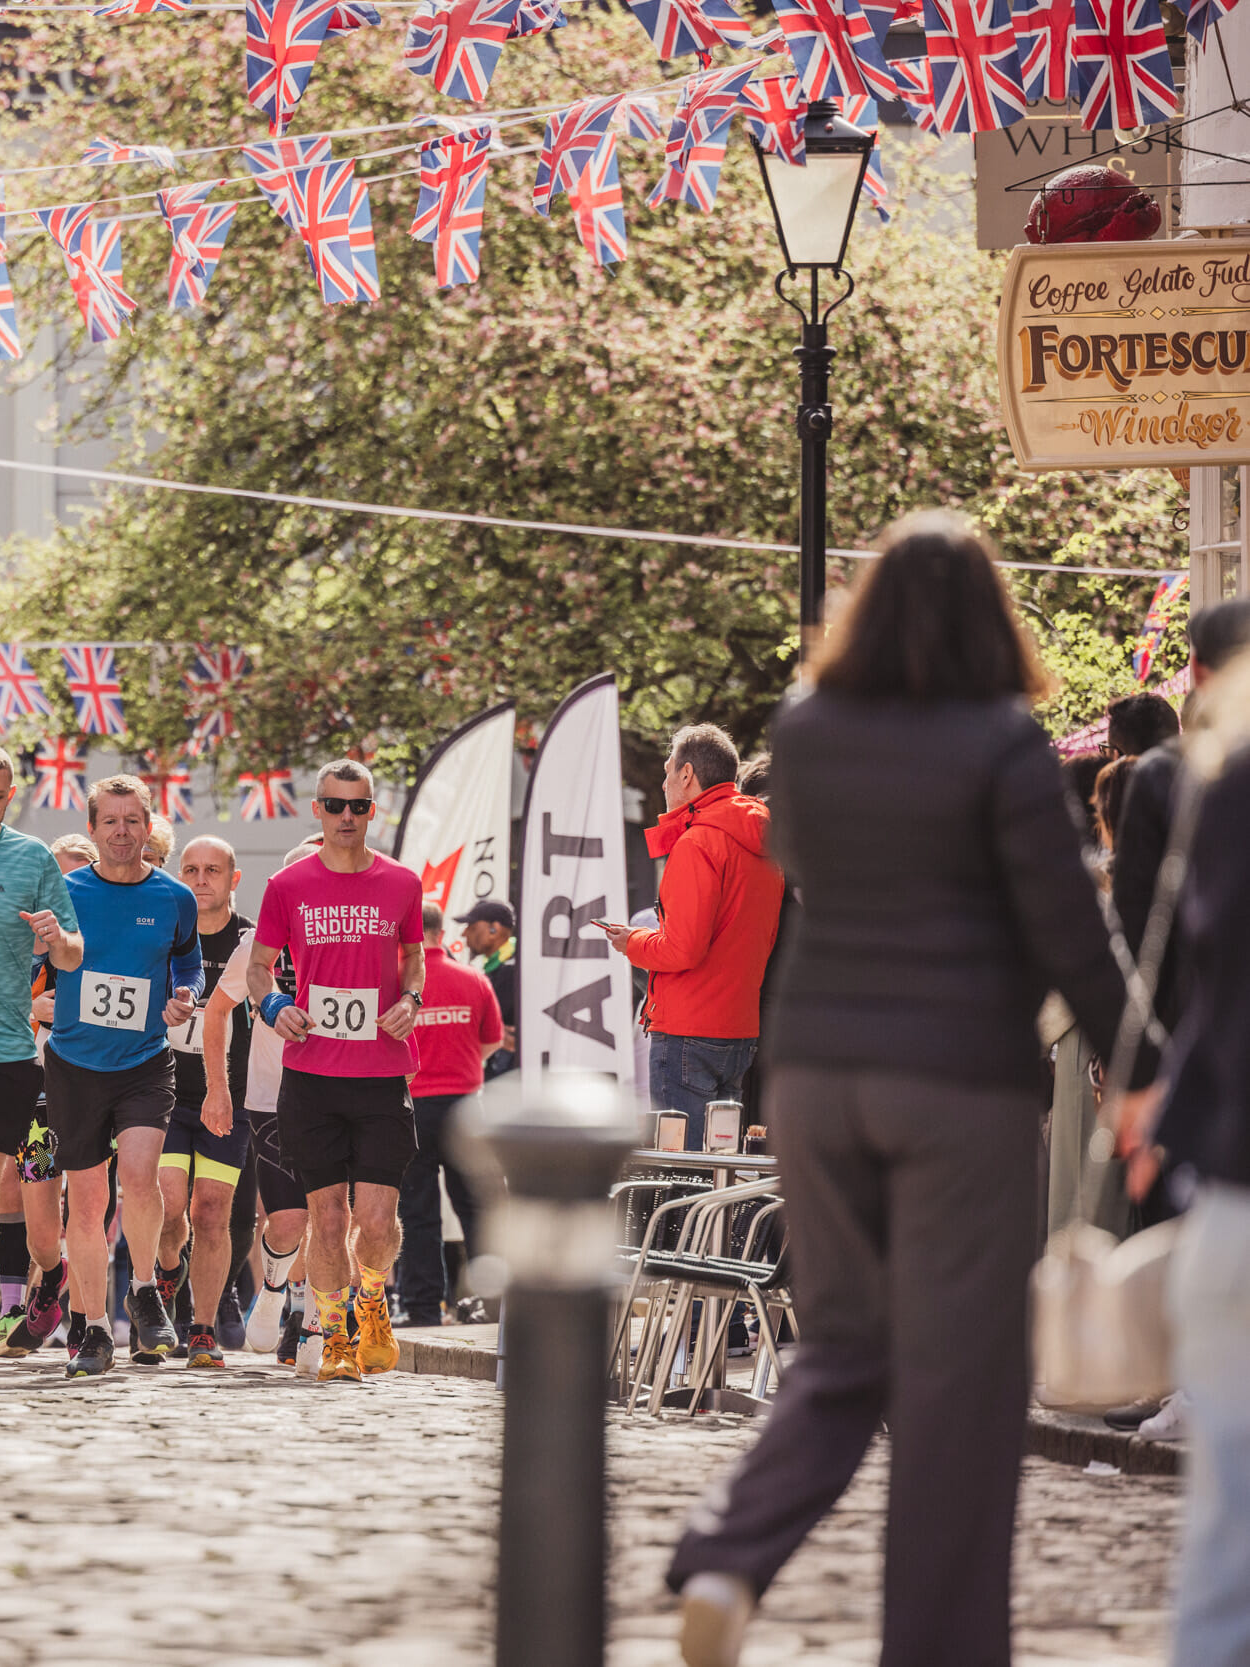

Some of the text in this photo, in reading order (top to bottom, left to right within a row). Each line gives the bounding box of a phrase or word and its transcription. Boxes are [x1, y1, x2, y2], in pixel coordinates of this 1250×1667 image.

[1028, 253, 1250, 314] Coffee Gelato Fud
[1018, 324, 1250, 394] FORTESCU
[1078, 400, 1244, 450] Windsor
[304, 905, 379, 921] HEINEKEN
[306, 934, 362, 946] READING 2022
[541, 811, 617, 1082] ART
[91, 983, 137, 1021] 35
[320, 997, 366, 1032] 30
[413, 1010, 471, 1027] MEDIC
